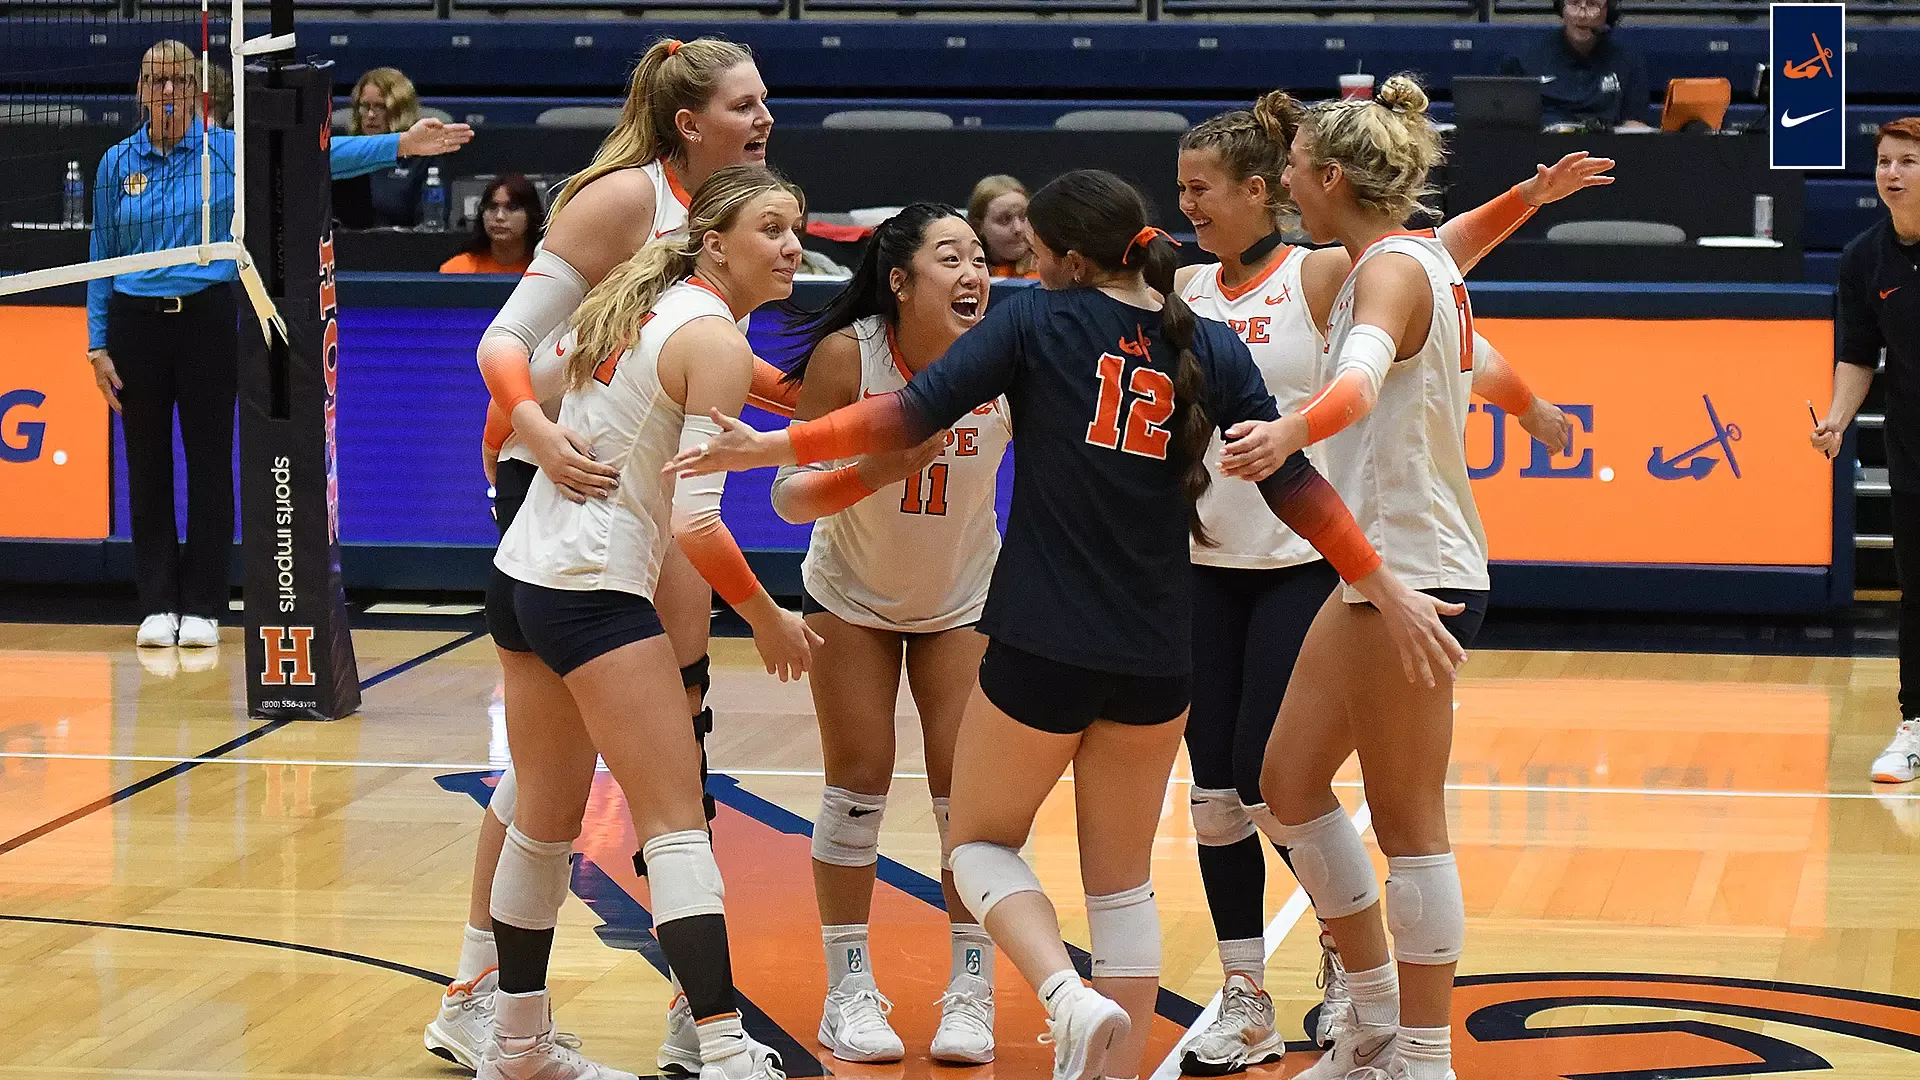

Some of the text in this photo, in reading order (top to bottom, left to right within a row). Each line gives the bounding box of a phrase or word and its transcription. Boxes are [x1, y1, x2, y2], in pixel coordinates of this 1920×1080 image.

[1085, 351, 1175, 460] 12
[900, 462, 949, 516] 11
[271, 456, 297, 613] sports imports
[260, 626, 316, 686] H
[261, 700, 317, 709] (800) 556-3198
